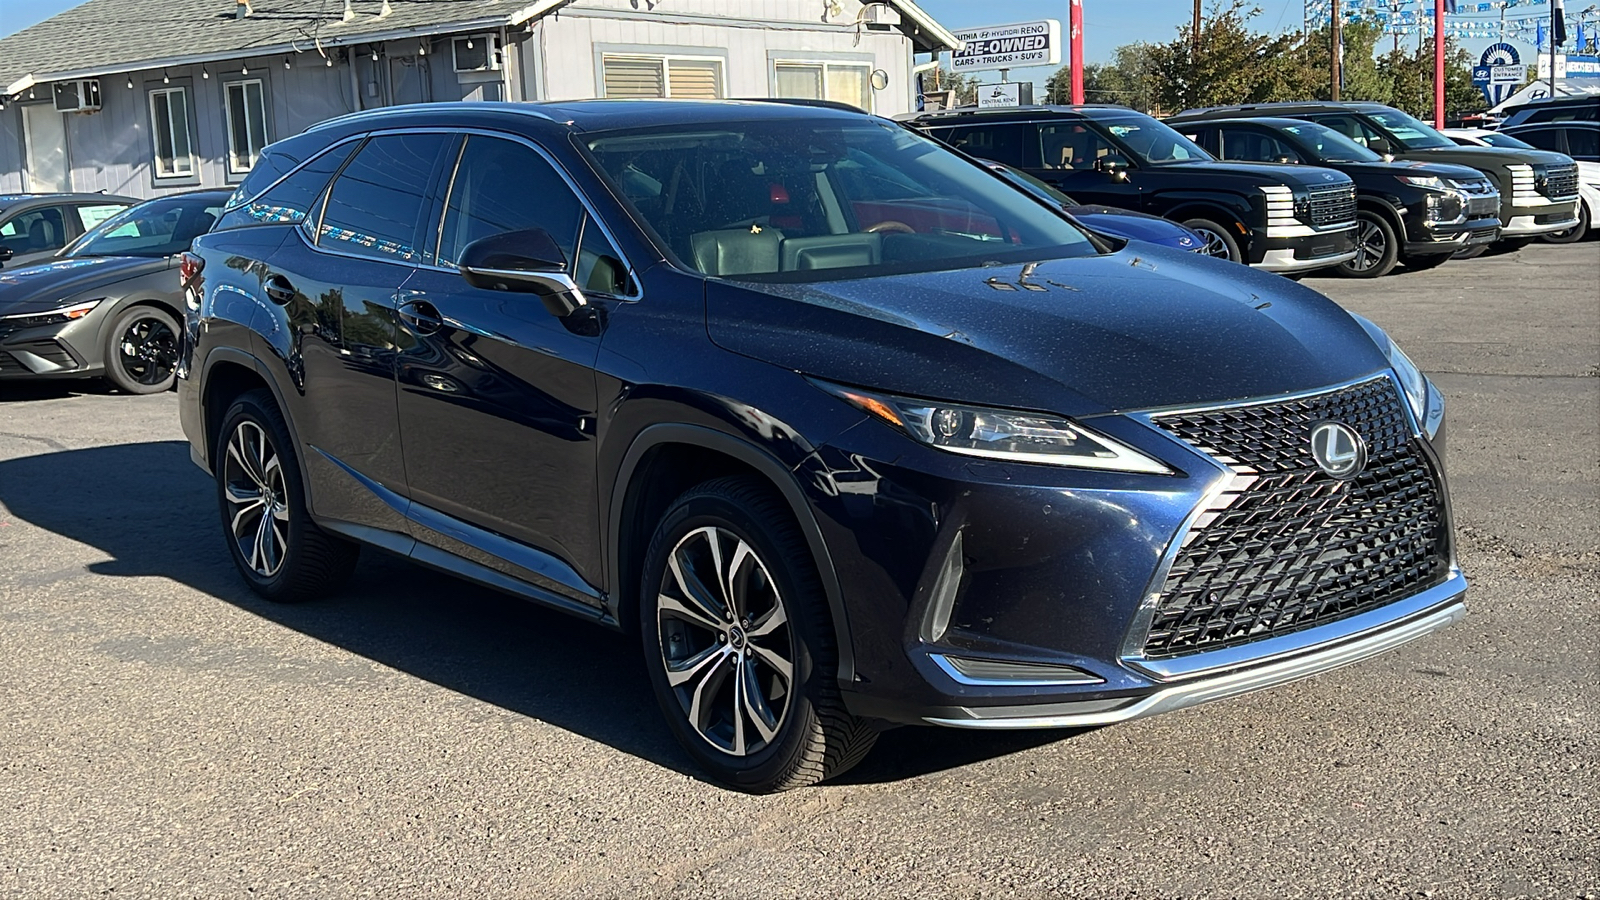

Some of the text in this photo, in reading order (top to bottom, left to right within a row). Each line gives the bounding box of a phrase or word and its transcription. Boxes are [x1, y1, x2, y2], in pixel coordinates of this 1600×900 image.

[1020, 26, 1044, 34] RENO
[955, 52, 1042, 66] CARS TRUCKS SUV'S
